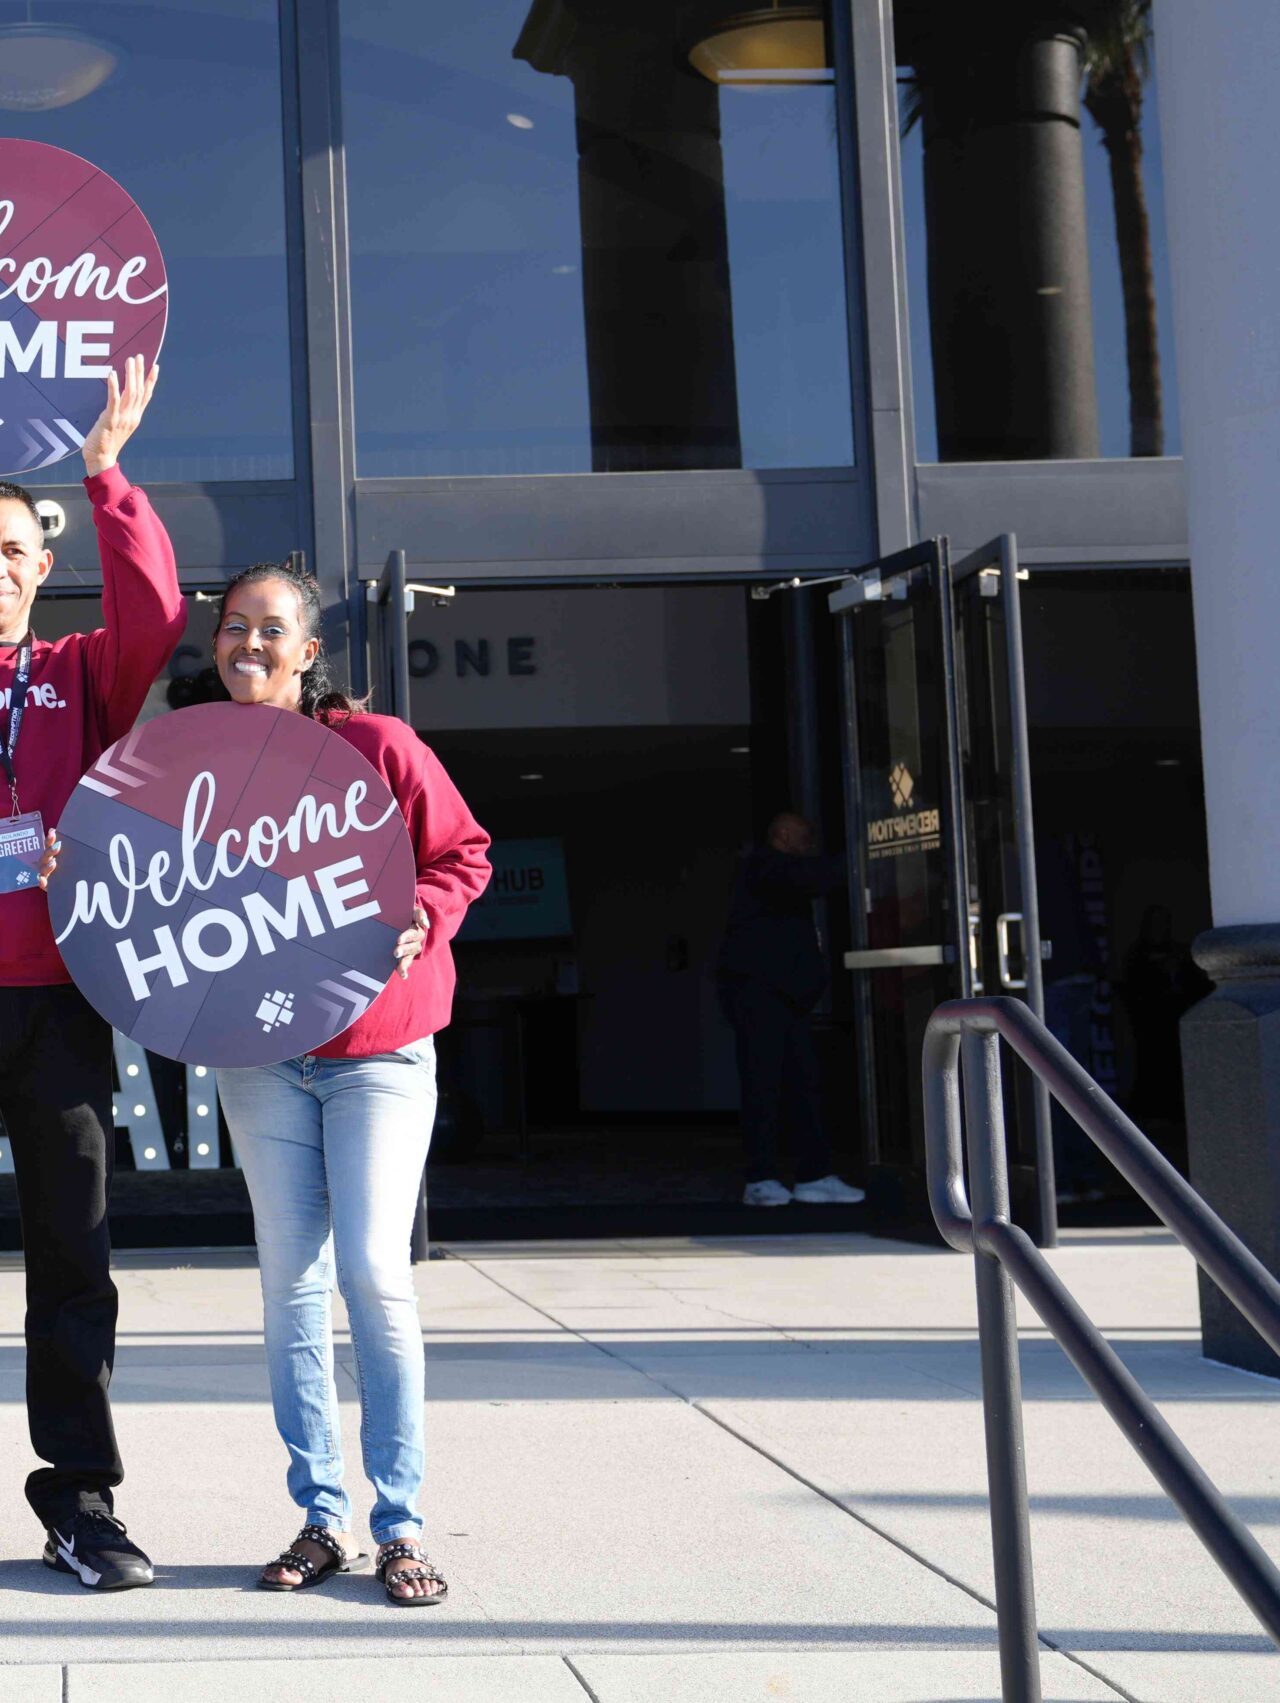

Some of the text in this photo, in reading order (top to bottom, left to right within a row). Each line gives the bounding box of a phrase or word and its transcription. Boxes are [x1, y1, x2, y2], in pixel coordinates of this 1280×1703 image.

[407, 638, 537, 678] ONE
[56, 771, 397, 945] welcome
[493, 867, 544, 892] HUB
[116, 856, 381, 1000] HOME
